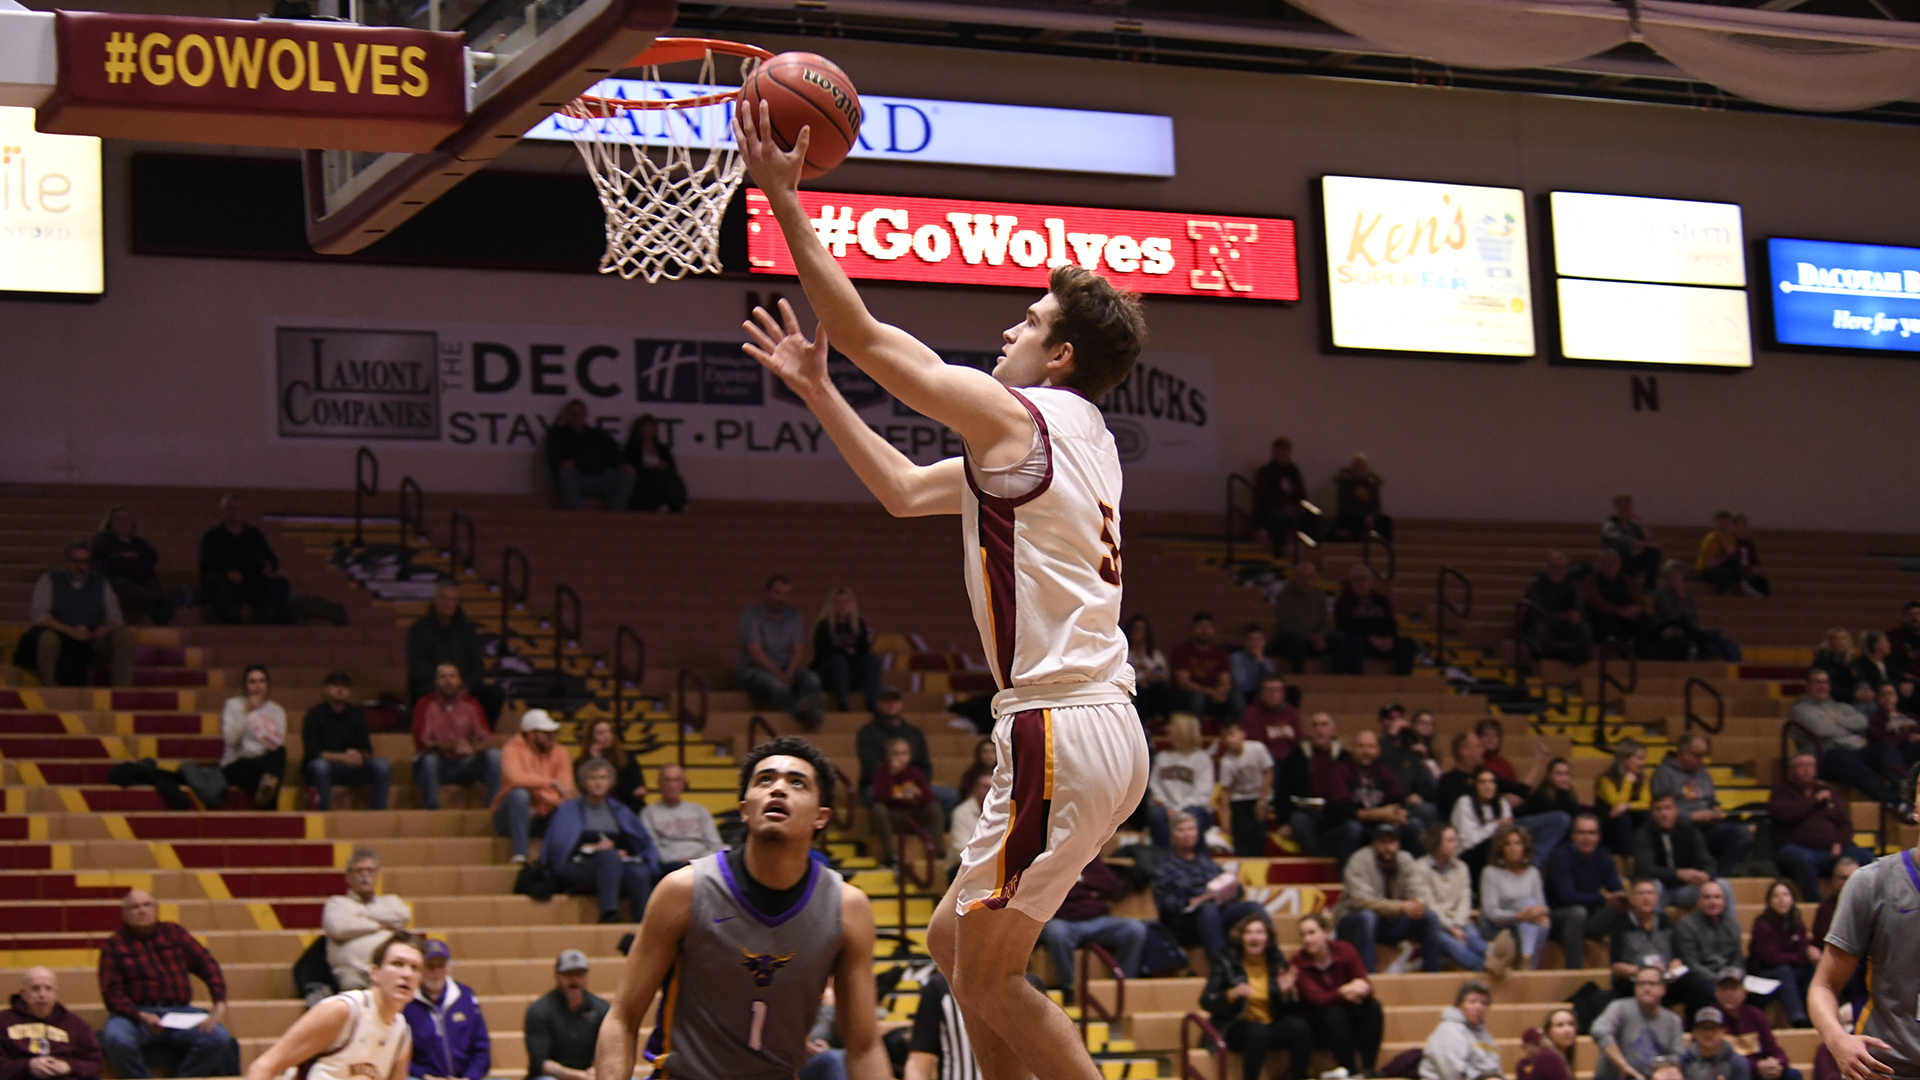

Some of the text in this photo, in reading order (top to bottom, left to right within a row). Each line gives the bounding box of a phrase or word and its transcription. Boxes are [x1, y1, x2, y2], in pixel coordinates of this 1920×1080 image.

[105, 31, 429, 97] #GOWOLVES
[803, 67, 860, 135] Wilson
[810, 205, 1175, 275] #GoWolves
[1346, 194, 1467, 268] Ken's
[1797, 262, 1902, 292] DACOTAH
[309, 338, 431, 394] LAMONT
[472, 341, 622, 398] DEC
[1097, 362, 1207, 426] RICKS
[1630, 375, 1659, 412] N
[284, 379, 432, 428] COMPANIES
[596, 415, 684, 452] ET
[715, 419, 824, 453] PLAY
[748, 1000, 768, 1051] 1
